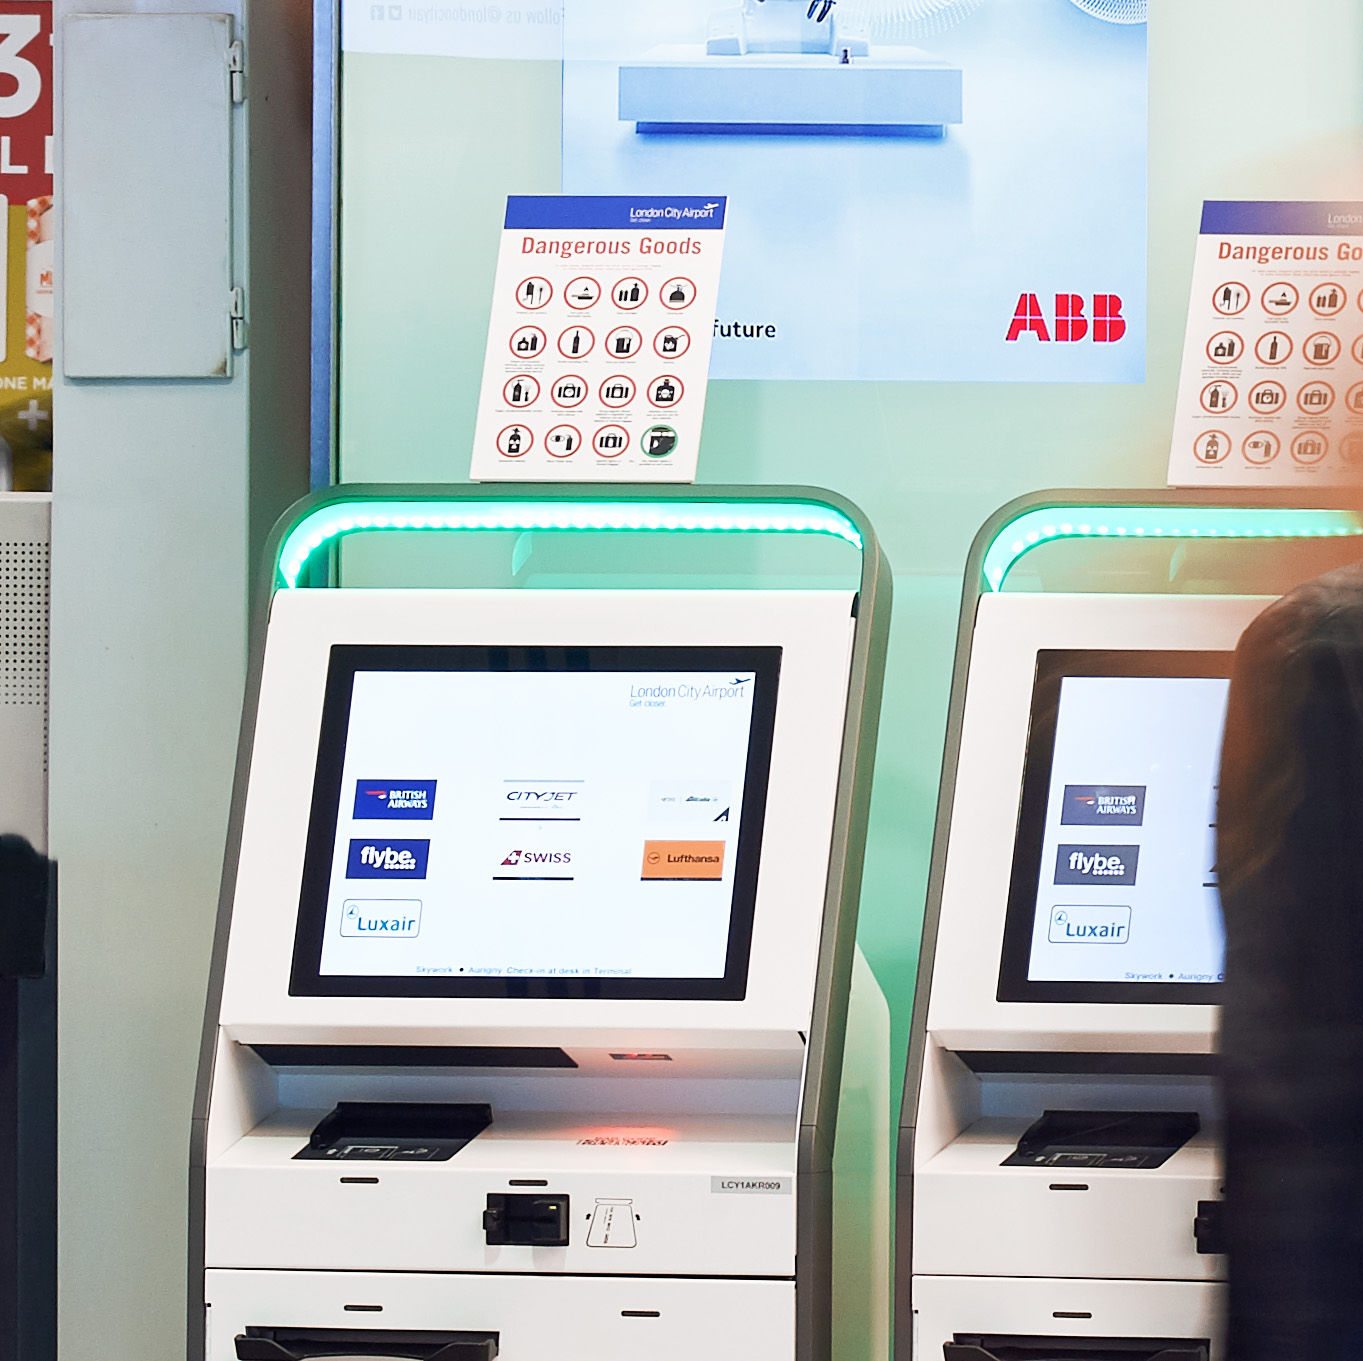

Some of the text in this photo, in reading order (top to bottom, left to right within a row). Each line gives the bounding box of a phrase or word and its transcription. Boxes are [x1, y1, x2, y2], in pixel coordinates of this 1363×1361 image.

[630, 206, 714, 220] London City Airport
[521, 237, 702, 258] Dangerous Goods
[1218, 242, 1328, 264] Dangerous
[1005, 292, 1126, 342] ABB
[630, 684, 744, 700] London City Airport
[389, 790, 427, 799] BRITISH
[507, 791, 577, 801] CITYJET
[387, 799, 428, 808] AIRWAYS
[1097, 796, 1136, 805] BRITISH
[1096, 805, 1137, 815] AIRWAYS
[524, 852, 571, 863] SWISS
[667, 853, 720, 864] Lufthansa
[357, 916, 416, 931] Luxair
[1066, 921, 1126, 937] Luxair
[721, 1180, 781, 1190] LCY1AKR009
